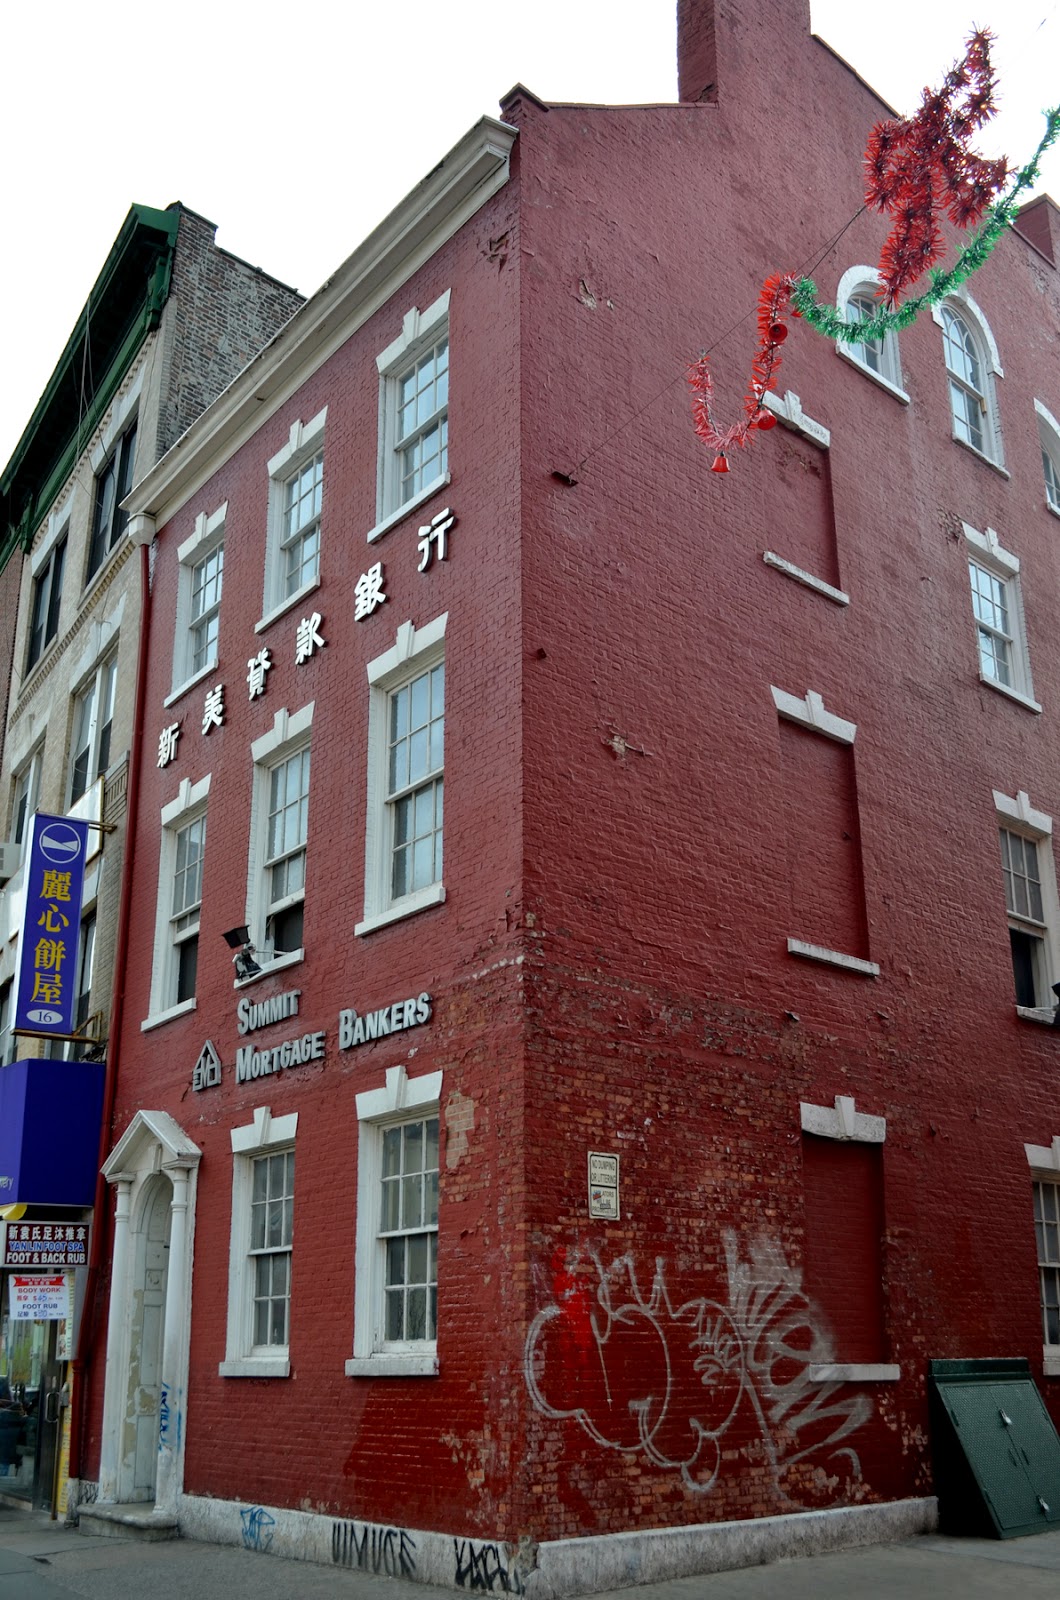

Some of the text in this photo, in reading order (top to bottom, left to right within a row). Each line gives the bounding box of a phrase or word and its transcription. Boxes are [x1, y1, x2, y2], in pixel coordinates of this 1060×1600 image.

[156, 507, 456, 769] 新美貸款銀行
[30, 869, 71, 1005] 麗心餅屋
[38, 1010, 53, 1023] 16
[237, 989, 301, 1035] SUMMIT
[235, 1031, 326, 1085] MORTGAGE
[339, 992, 433, 1050] BANKERS
[7, 1252, 86, 1264] FOOT & BACK RUB
[9, 1241, 85, 1252] YAN LIN FOOT SPA
